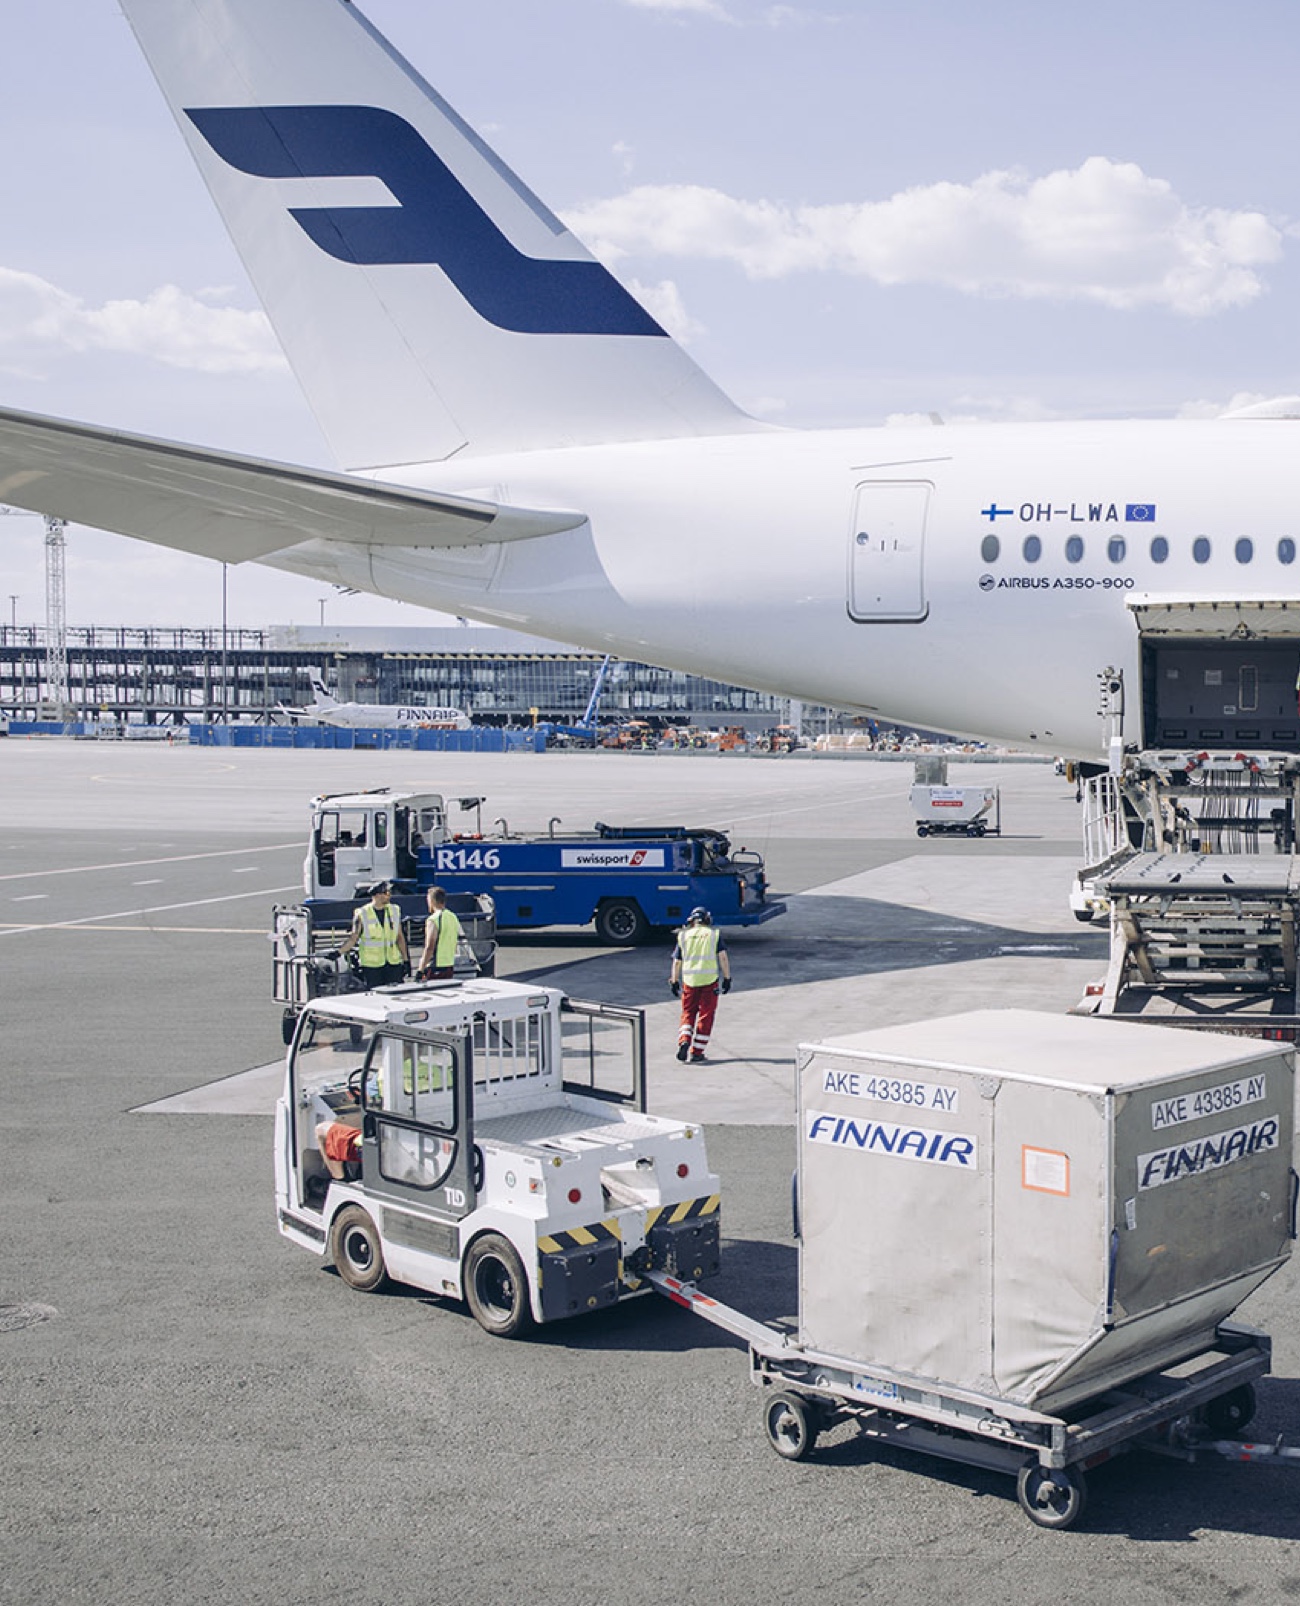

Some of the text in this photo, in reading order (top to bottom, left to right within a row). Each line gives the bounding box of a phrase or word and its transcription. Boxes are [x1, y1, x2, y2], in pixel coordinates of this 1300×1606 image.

[1019, 503, 1118, 522] OH-LWA
[998, 577, 1135, 589] AIRBUS A350-900
[437, 848, 501, 870] R146
[576, 853, 630, 866] swissport
[824, 1071, 957, 1111] AKE 43385 AY
[1154, 1076, 1265, 1128] AKE 43385 AY
[809, 1116, 974, 1165] FINNAIR
[1140, 1120, 1278, 1187] FINNAIR
